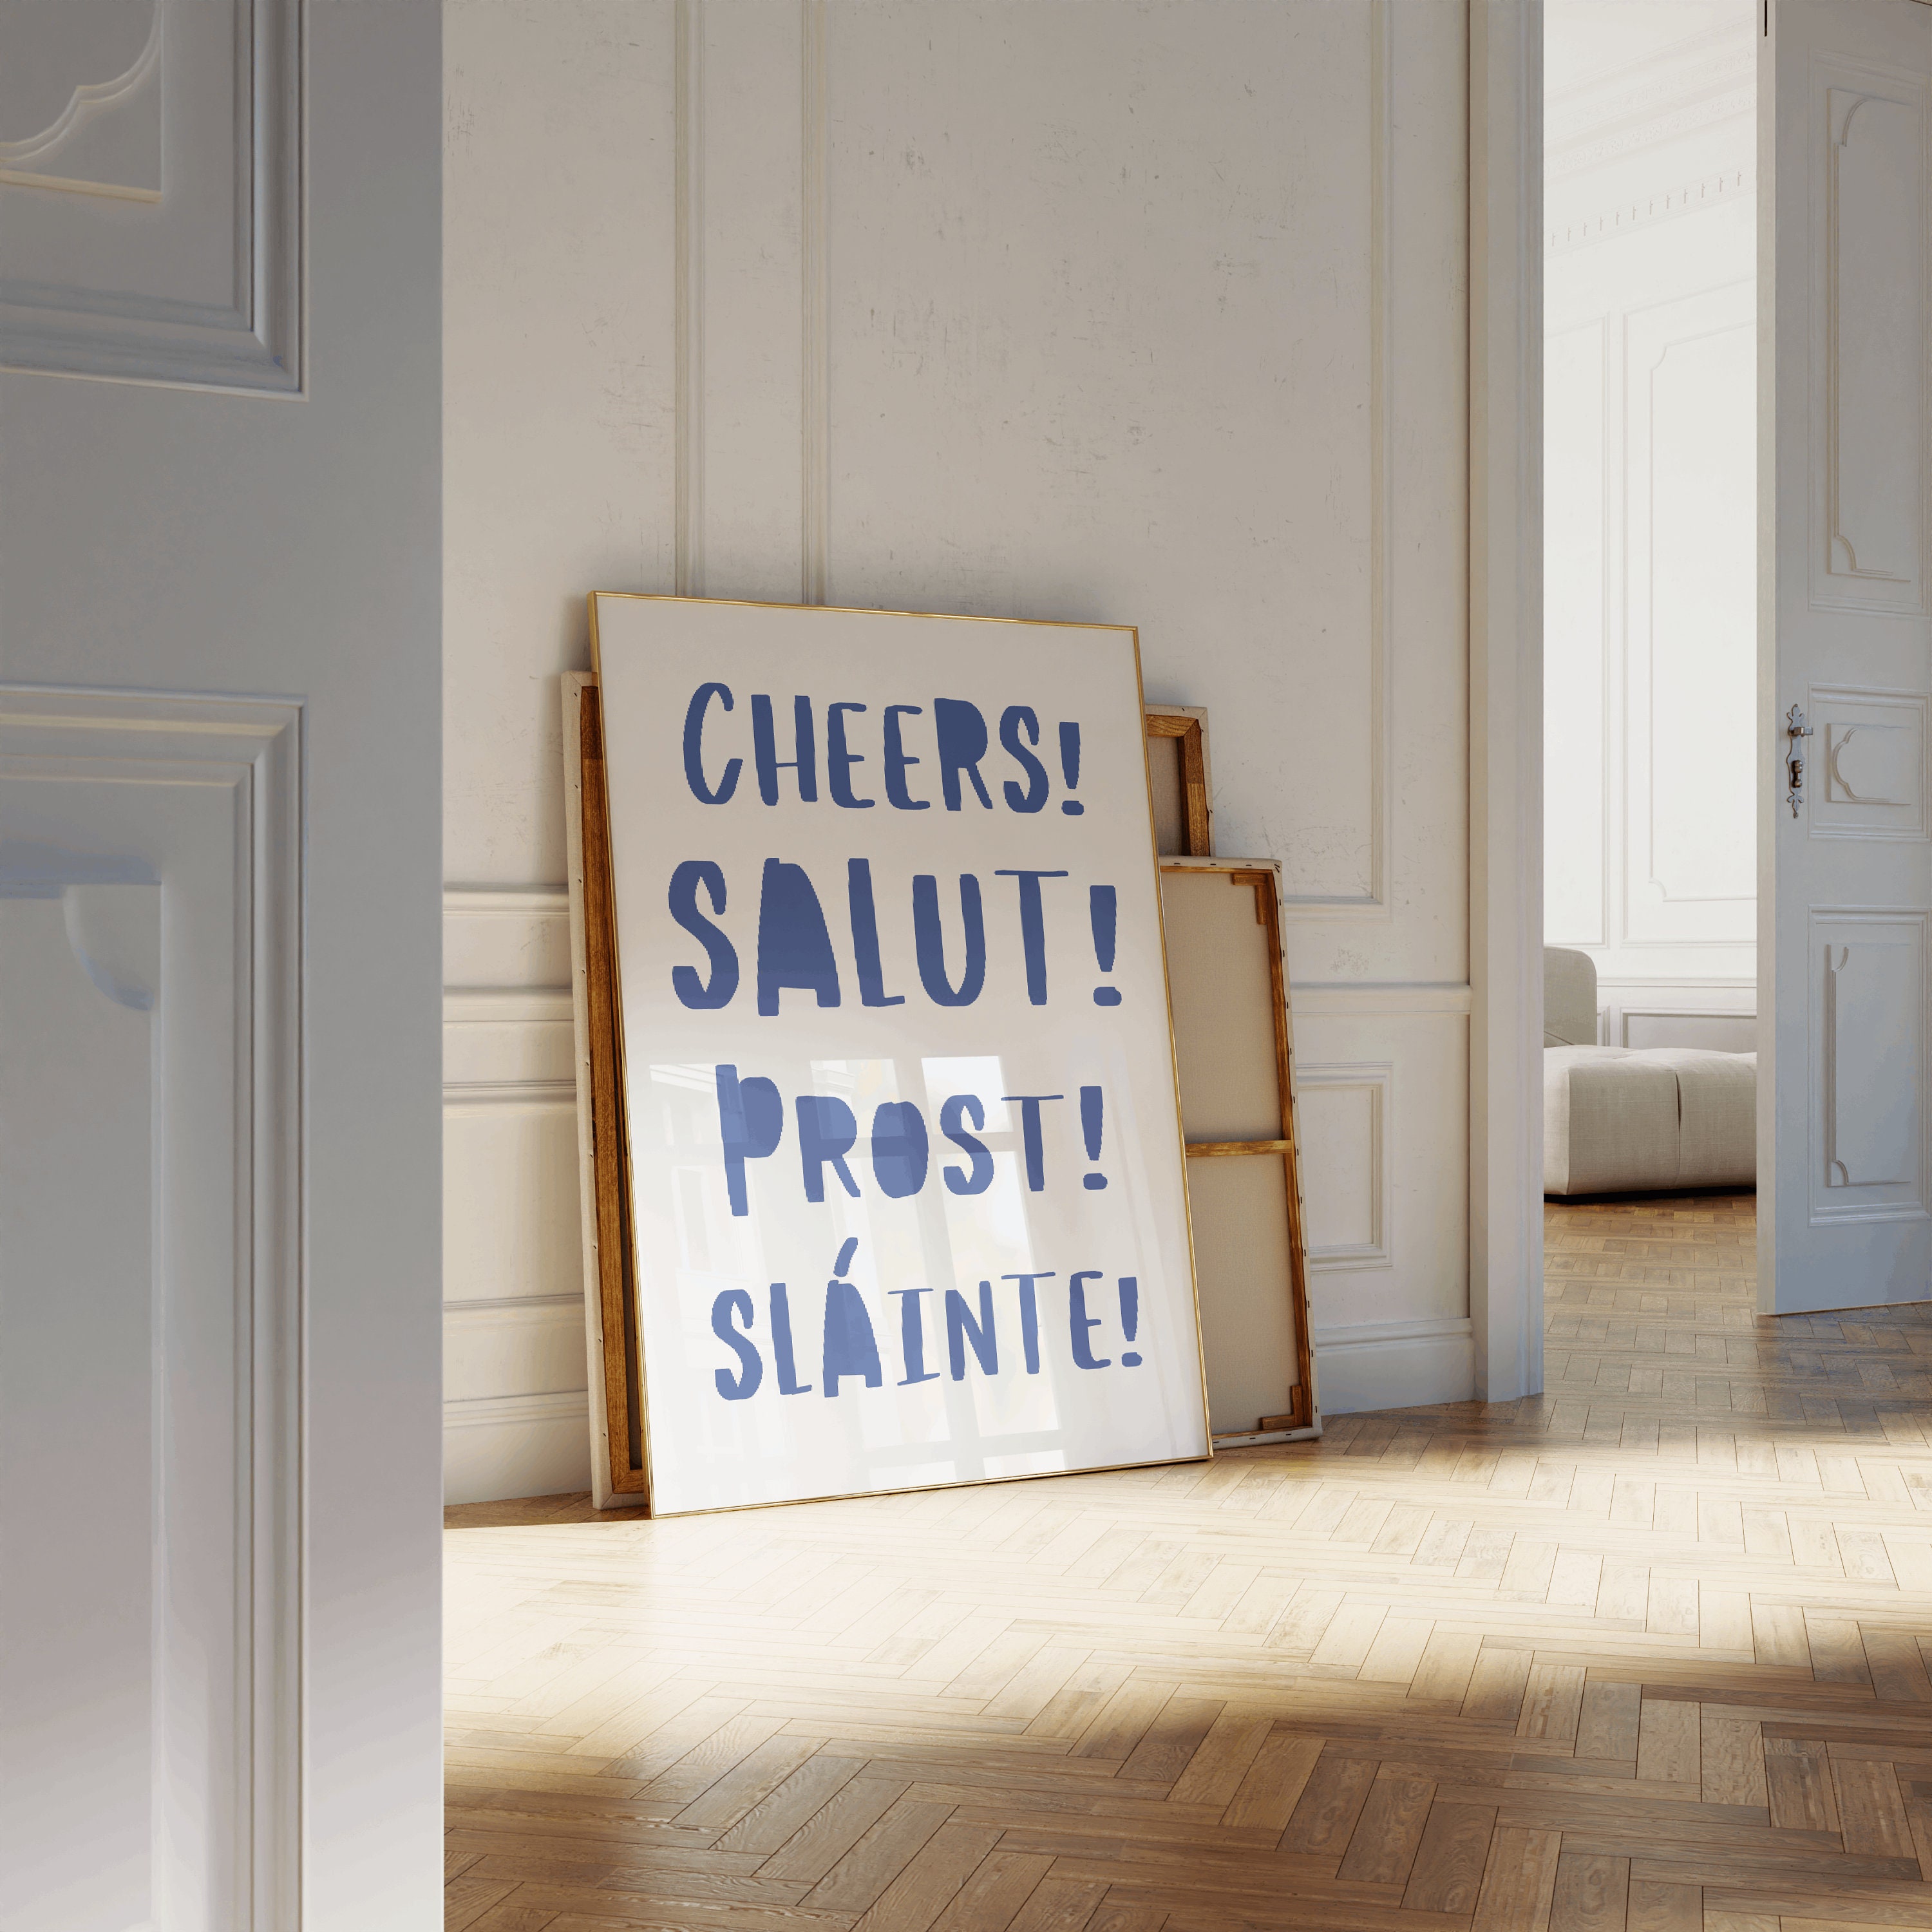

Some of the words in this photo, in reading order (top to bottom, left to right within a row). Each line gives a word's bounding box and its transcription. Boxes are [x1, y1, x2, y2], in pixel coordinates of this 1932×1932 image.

[683, 683, 1084, 815] CHEERS!
[668, 858, 1121, 1016] SALUT!
[715, 1065, 1108, 1216] PROST!
[711, 1238, 1142, 1400] SLÁINTE!
